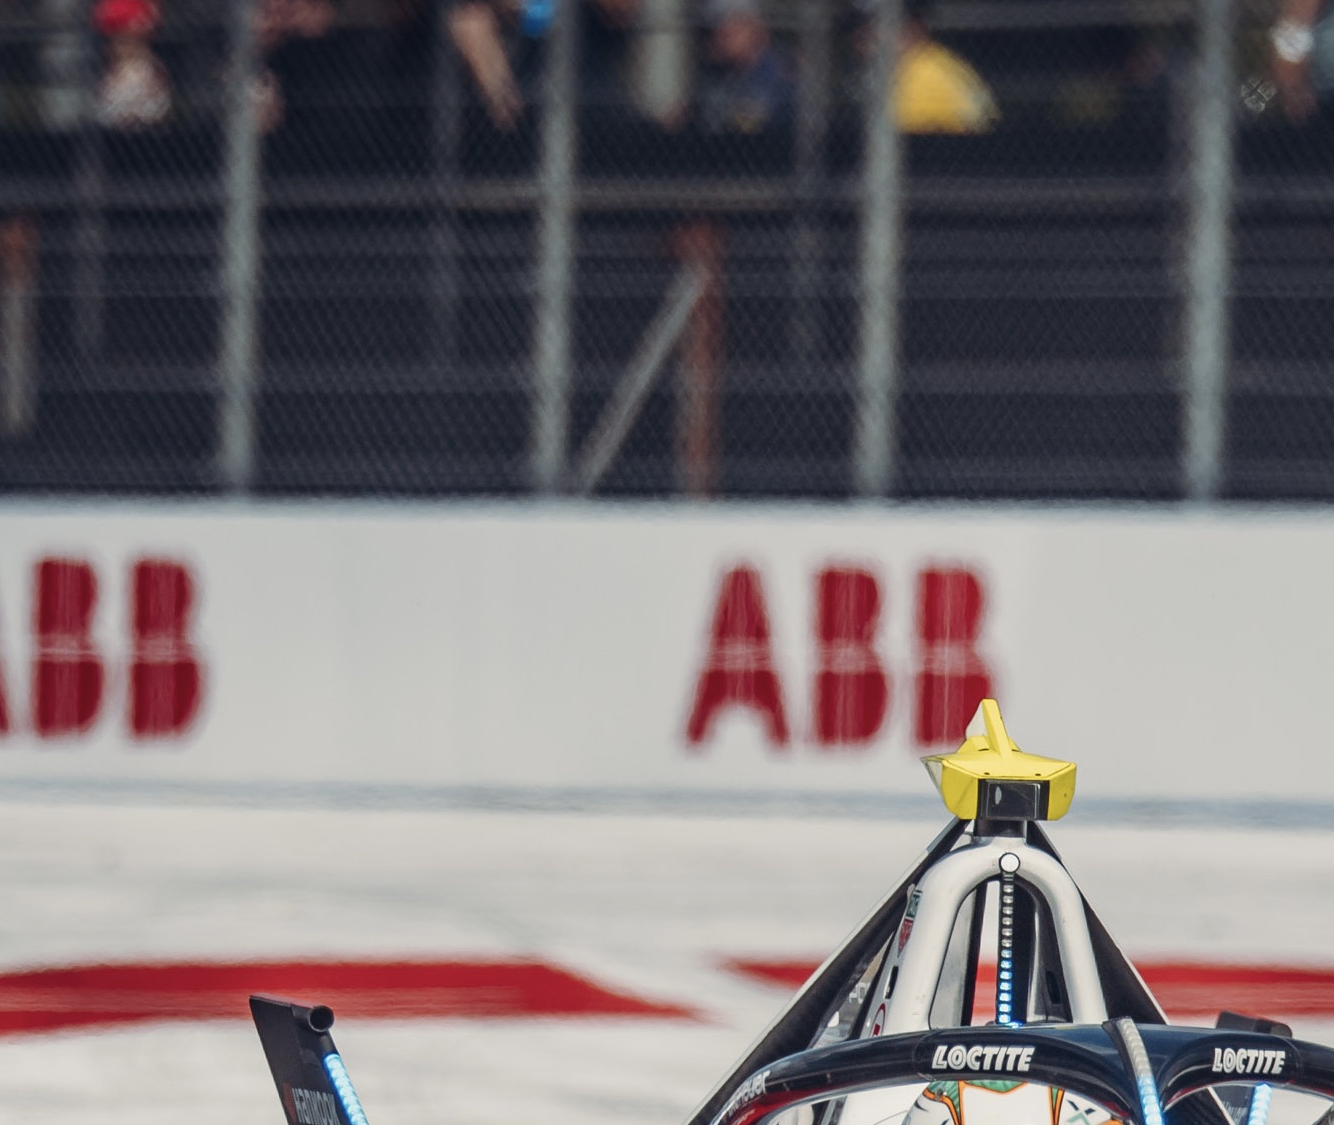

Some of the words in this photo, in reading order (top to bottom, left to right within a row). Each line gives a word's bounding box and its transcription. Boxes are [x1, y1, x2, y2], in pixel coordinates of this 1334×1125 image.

[685, 564, 992, 749] ABB
[931, 1045, 1035, 1071] LOCTITE
[1212, 1048, 1285, 1074] LOCTITE
